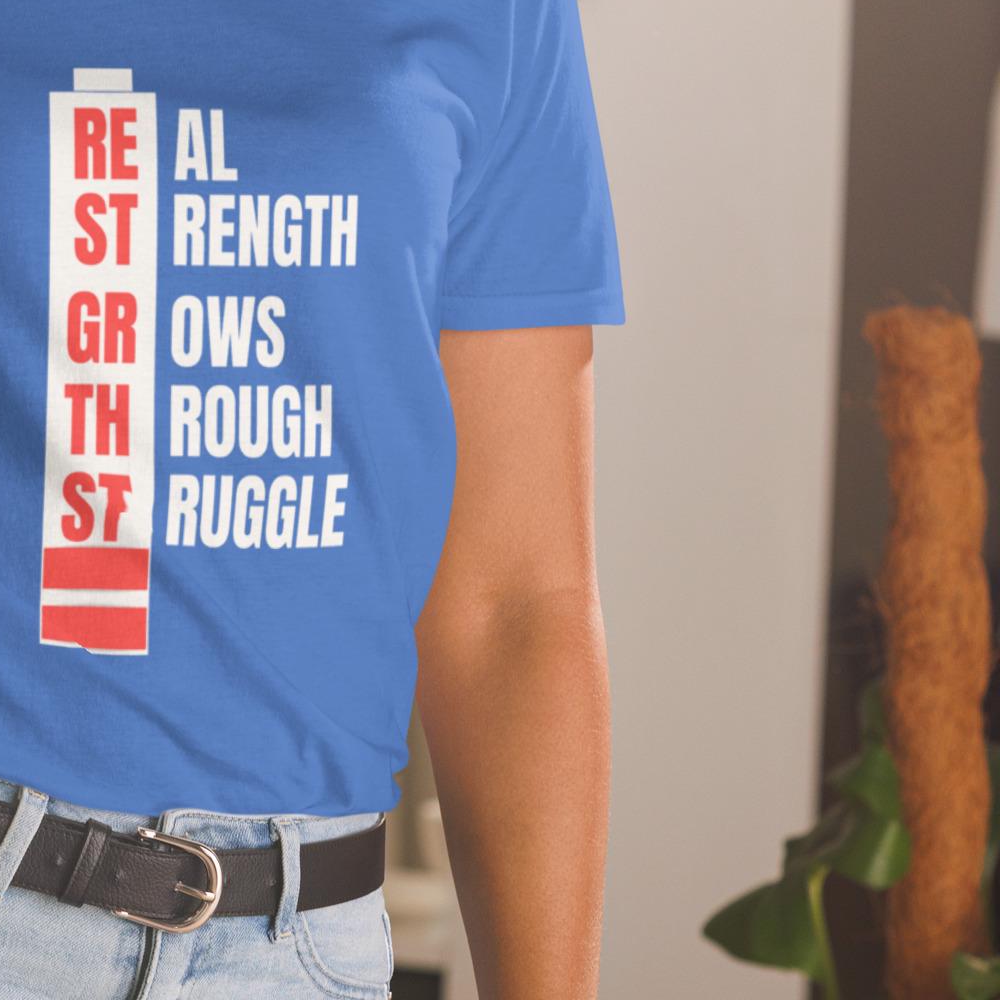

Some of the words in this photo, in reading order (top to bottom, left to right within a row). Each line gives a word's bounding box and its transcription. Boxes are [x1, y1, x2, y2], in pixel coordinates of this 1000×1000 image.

[73, 107, 139, 180] RE
[174, 108, 238, 181] AL
[74, 192, 139, 266] ST
[173, 193, 358, 267] RENGTH
[66, 291, 138, 364] GR
[170, 295, 286, 368] OWS
[64, 383, 130, 456] TH
[169, 384, 332, 459] ROUGH
[165, 473, 349, 549] RUGGLE
